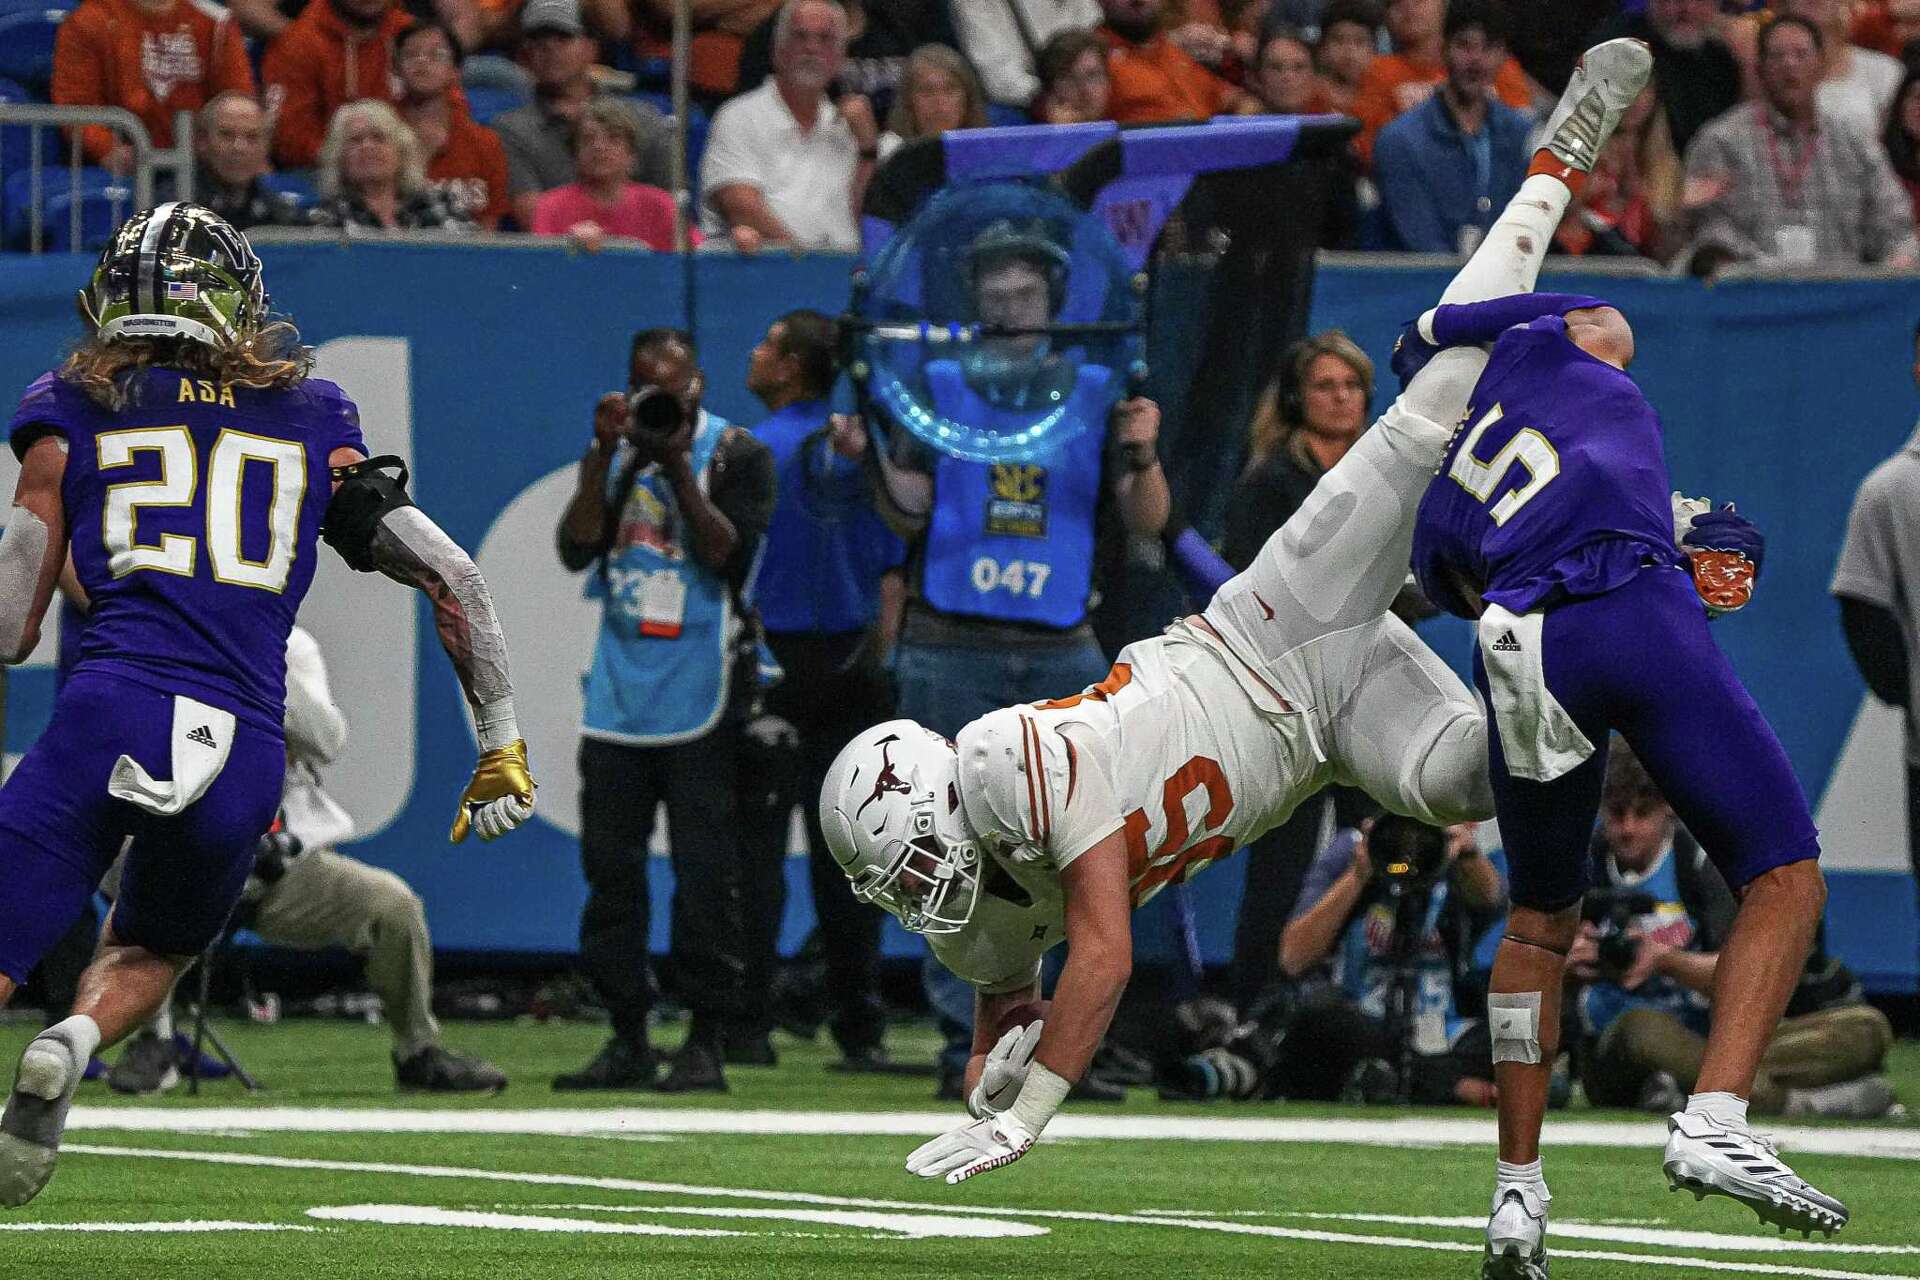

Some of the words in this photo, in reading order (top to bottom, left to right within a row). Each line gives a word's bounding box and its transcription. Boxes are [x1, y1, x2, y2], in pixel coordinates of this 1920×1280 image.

[178, 377, 236, 409] ASA
[1448, 402, 1560, 528] 5
[95, 424, 308, 595] 20
[972, 557, 1052, 600] 047
[185, 733, 217, 749] adidas
